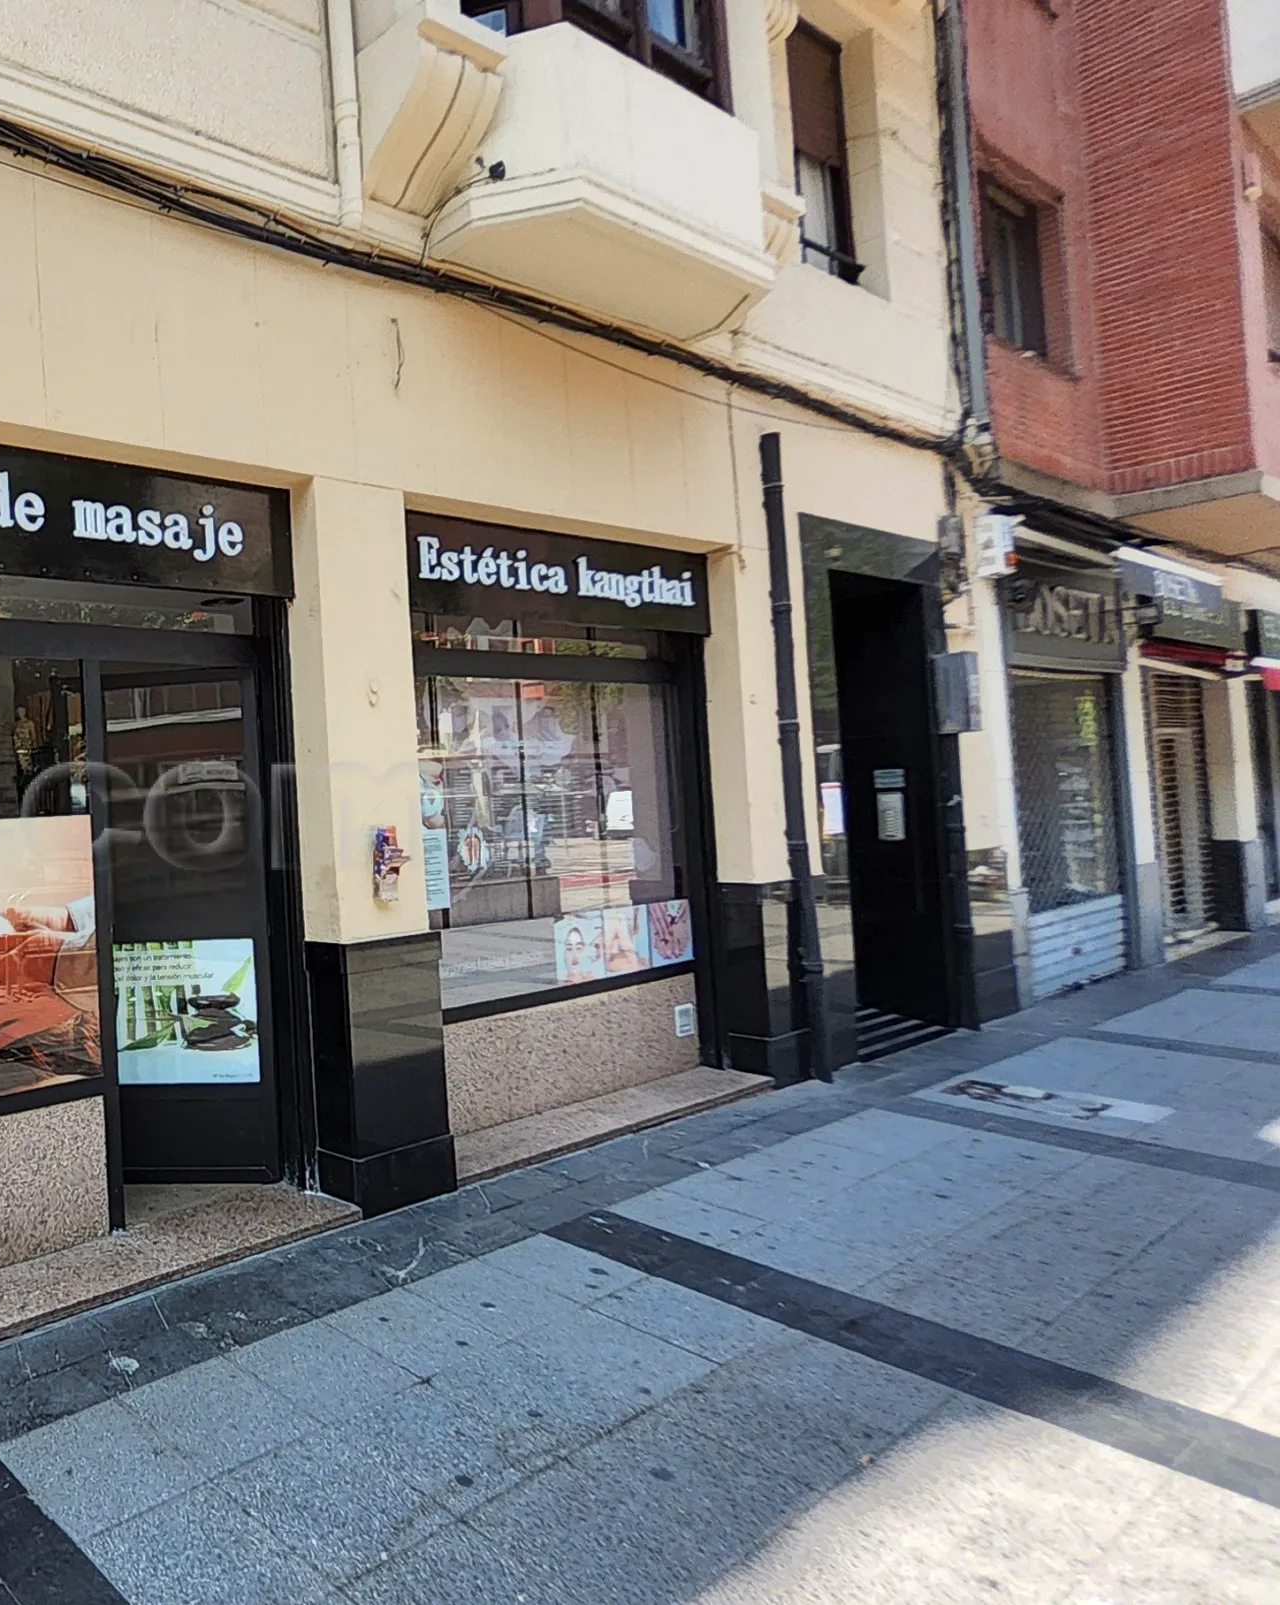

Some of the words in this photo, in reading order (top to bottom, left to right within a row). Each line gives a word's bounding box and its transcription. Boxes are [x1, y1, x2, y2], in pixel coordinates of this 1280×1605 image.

[72, 499, 244, 563] masaje
[417, 536, 568, 595] Estética
[575, 556, 697, 608] kangthai
